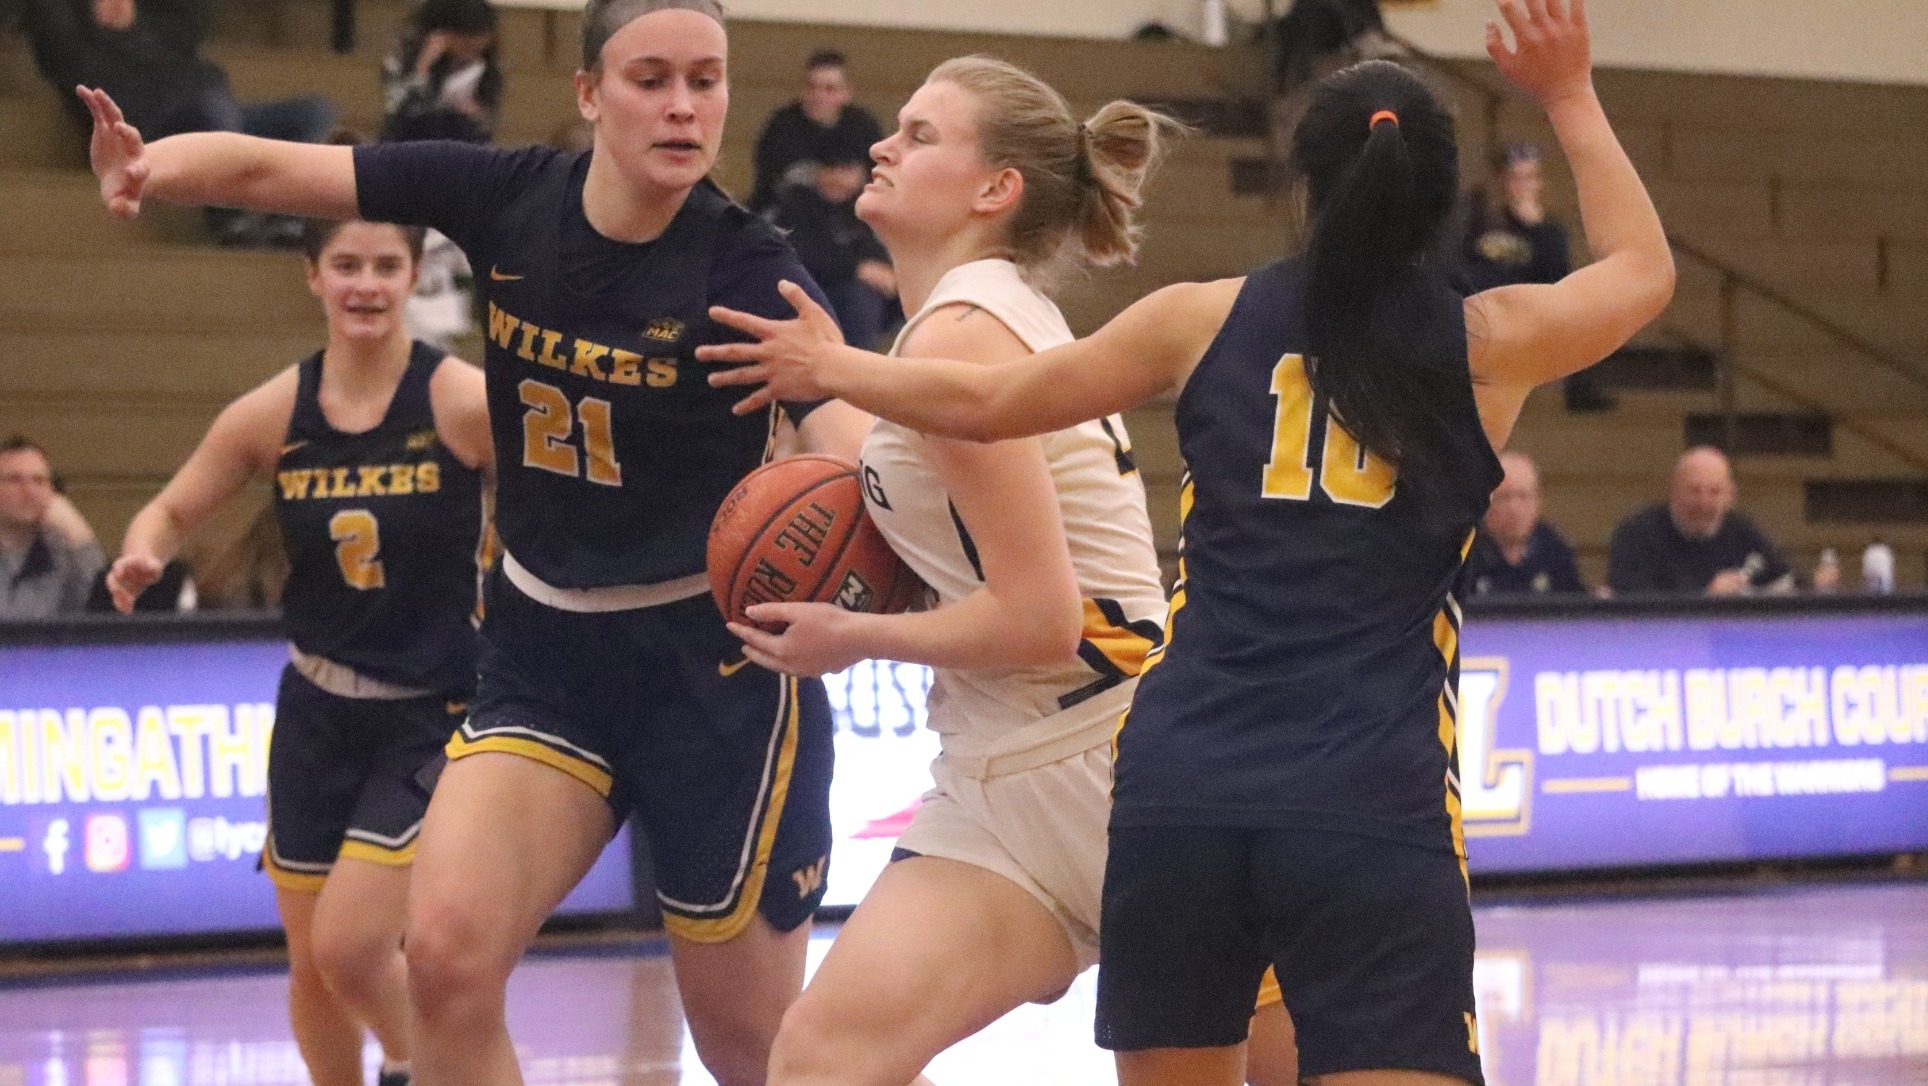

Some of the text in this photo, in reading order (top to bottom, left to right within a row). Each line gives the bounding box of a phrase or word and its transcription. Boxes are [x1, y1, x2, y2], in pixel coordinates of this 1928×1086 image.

[488, 300, 678, 388] WILKES
[646, 327, 679, 340] MAC
[518, 378, 623, 487] 21
[1261, 352, 1397, 509] 10
[277, 460, 441, 500] WILKES
[328, 508, 386, 591] 2
[774, 502, 836, 568] THE
[1534, 669, 1682, 754] DUTCH
[1684, 666, 1830, 750] BURCH
[792, 855, 827, 899] W
